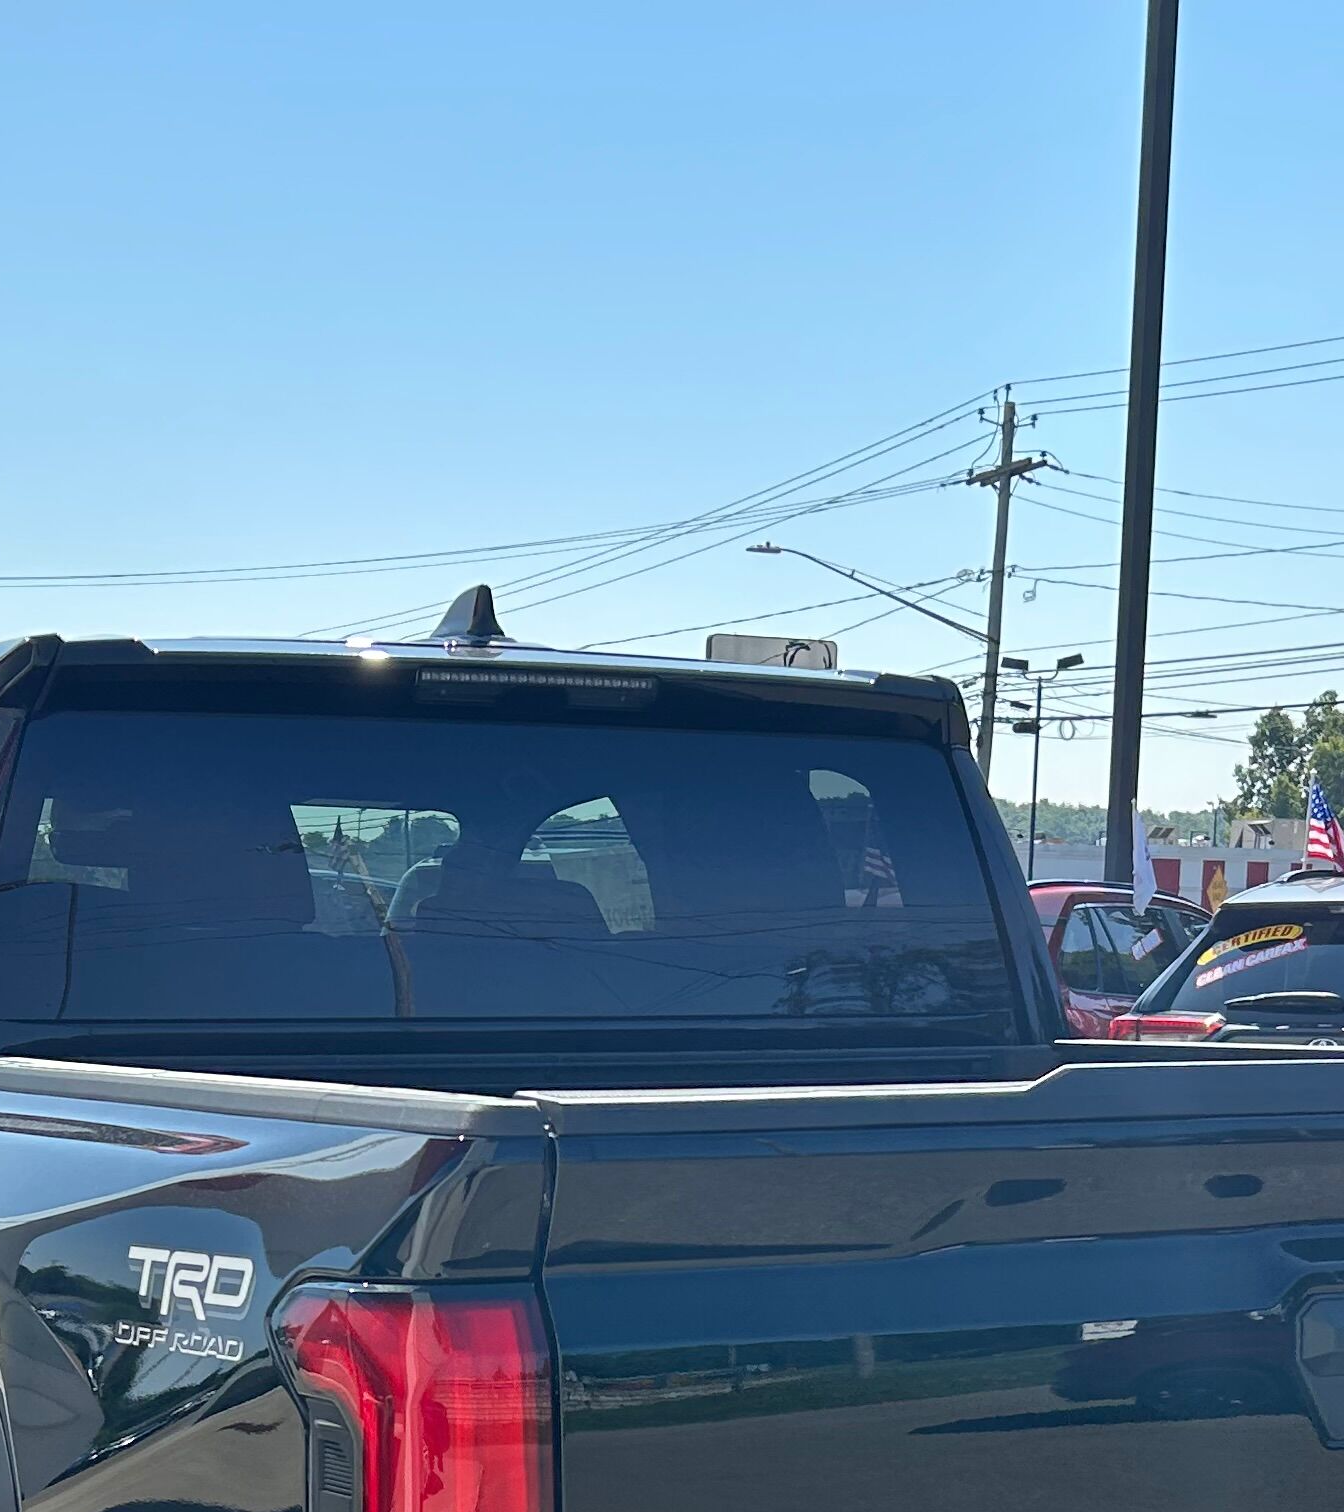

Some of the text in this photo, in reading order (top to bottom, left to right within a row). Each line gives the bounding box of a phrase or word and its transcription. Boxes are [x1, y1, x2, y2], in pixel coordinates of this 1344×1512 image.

[1212, 925, 1294, 956] CERTIFIED
[1245, 938, 1307, 967] CARFAX
[128, 1245, 254, 1321] TRD
[114, 1321, 244, 1361] OFF ROAD
